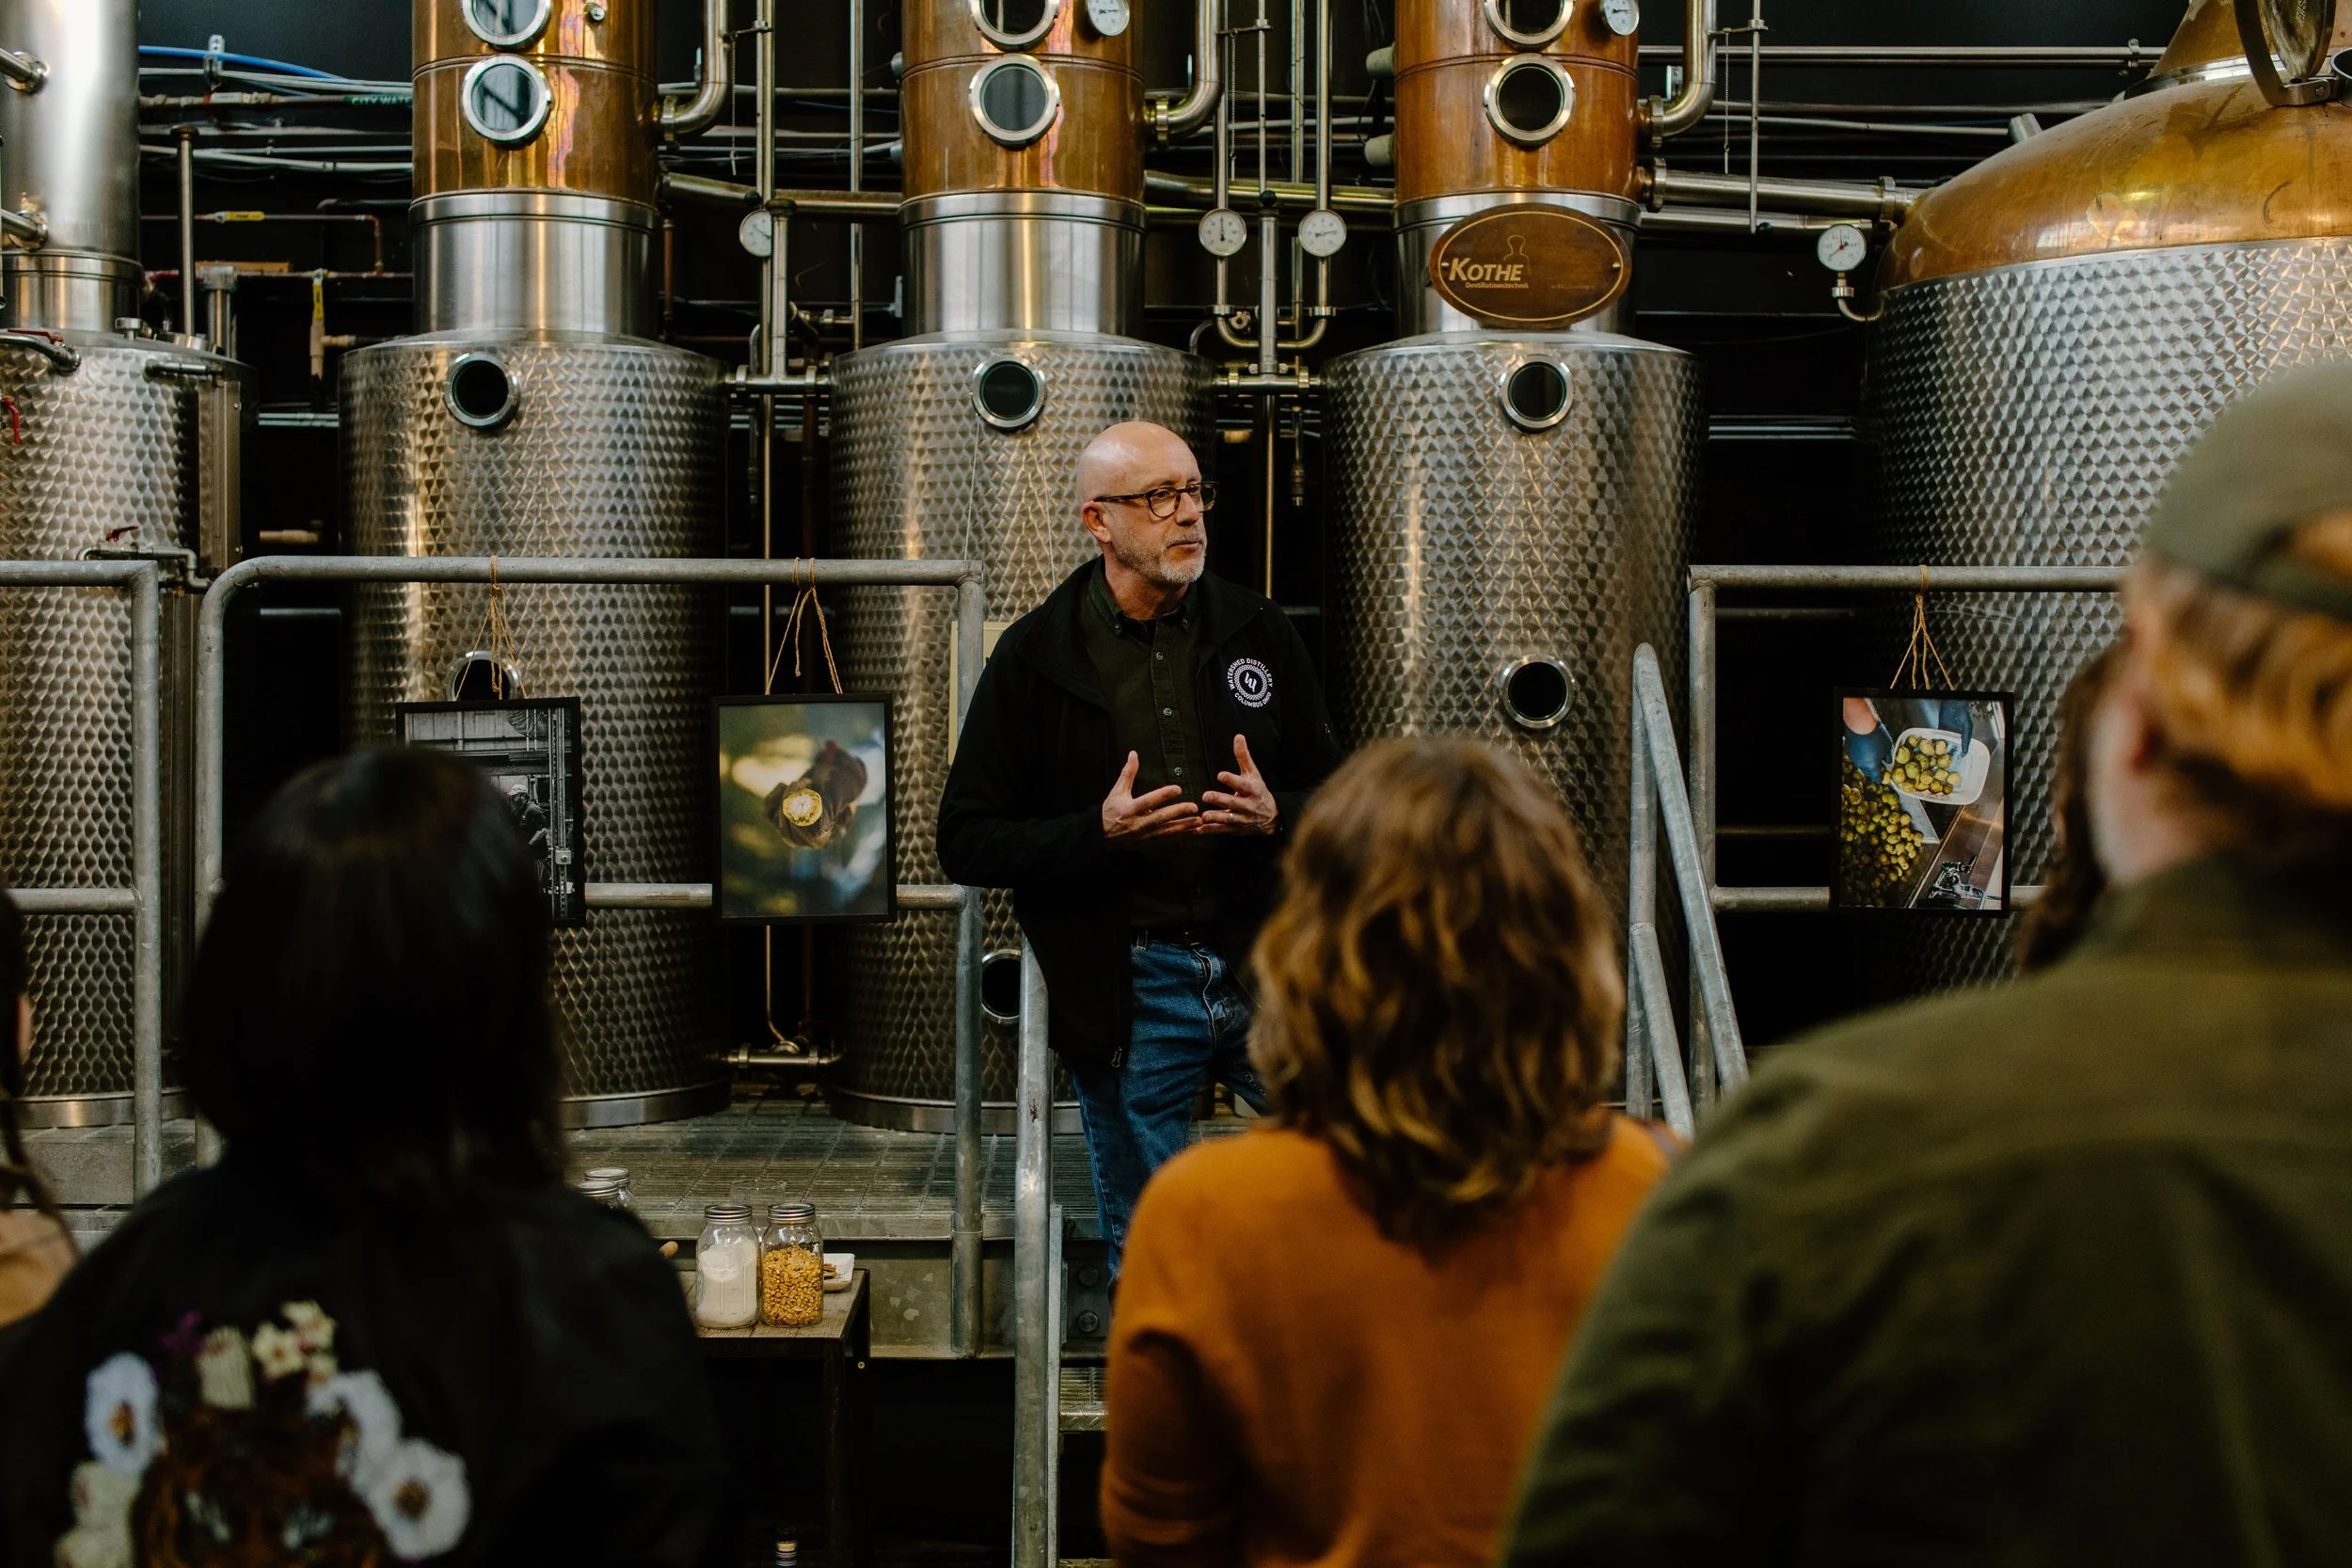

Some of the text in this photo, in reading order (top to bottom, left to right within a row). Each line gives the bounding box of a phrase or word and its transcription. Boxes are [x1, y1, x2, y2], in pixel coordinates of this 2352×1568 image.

[351, 96, 377, 104] CITY
[1227, 658, 1273, 689] WATERSHED DISTILLERY
[1234, 691, 1272, 707] COLUMBUS OHIO
